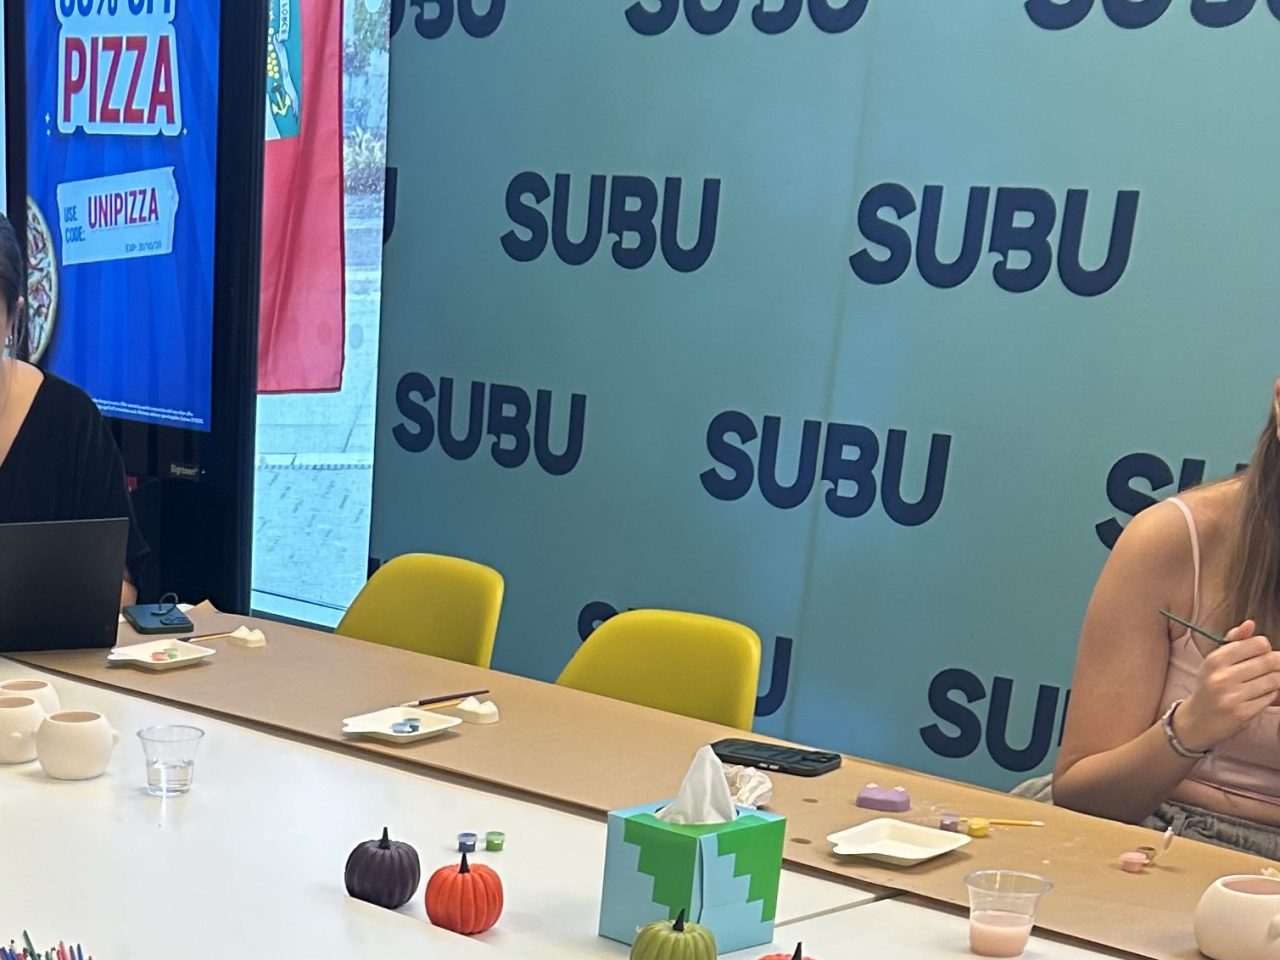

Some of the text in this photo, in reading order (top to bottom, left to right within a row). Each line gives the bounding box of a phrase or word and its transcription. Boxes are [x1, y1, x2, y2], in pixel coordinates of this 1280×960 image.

[62, 34, 176, 125] PIZZA
[63, 205, 78, 223] USE
[64, 226, 86, 244] CODE:
[87, 187, 160, 230] UNIPIZZA
[500, 172, 721, 273] SUBU
[849, 183, 1140, 297] SUBU
[392, 372, 587, 477] SUBU
[700, 410, 952, 527] SUBU
[919, 668, 1072, 773] SU
